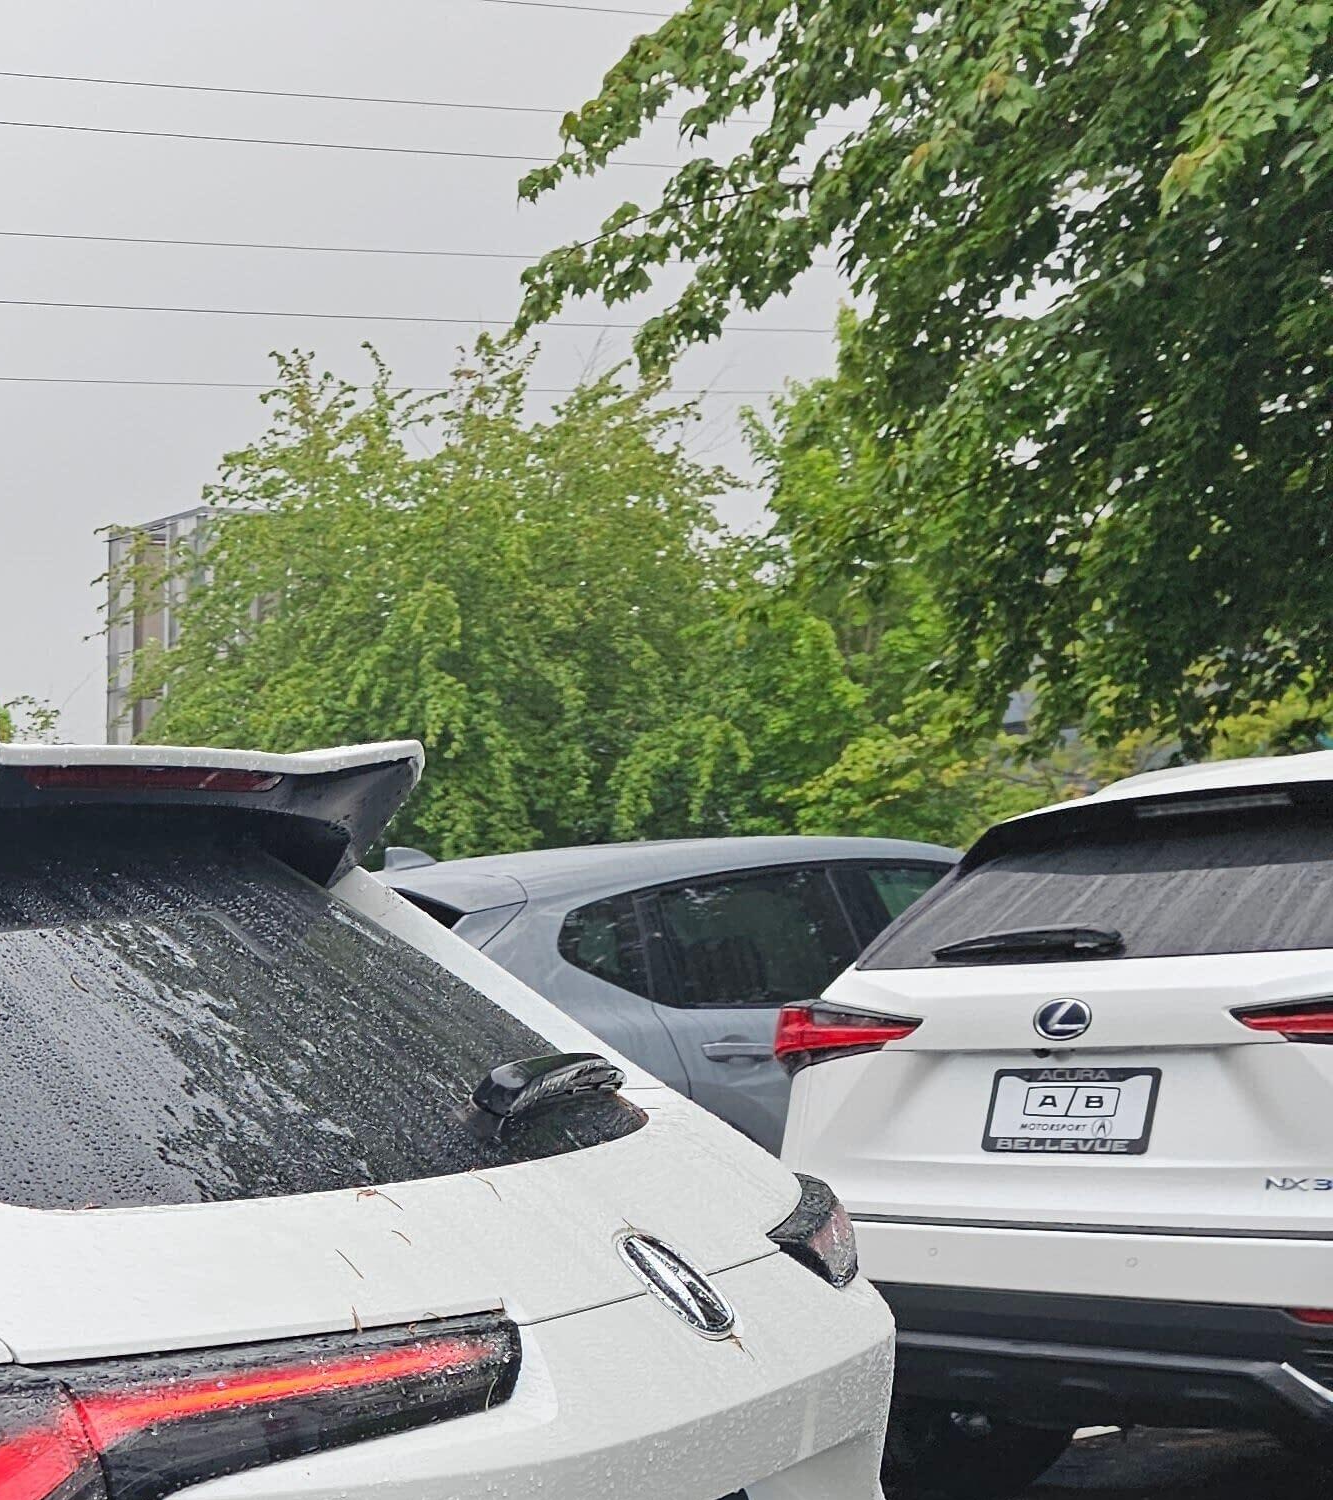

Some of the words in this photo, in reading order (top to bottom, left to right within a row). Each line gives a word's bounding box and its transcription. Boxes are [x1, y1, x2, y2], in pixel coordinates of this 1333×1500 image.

[1037, 1069, 1110, 1081] ACURA
[1038, 1095, 1058, 1108] A
[1085, 1095, 1104, 1109] B
[1019, 1122, 1087, 1132] MOTORSPORT
[995, 1138, 1130, 1152] BELLEVUE
